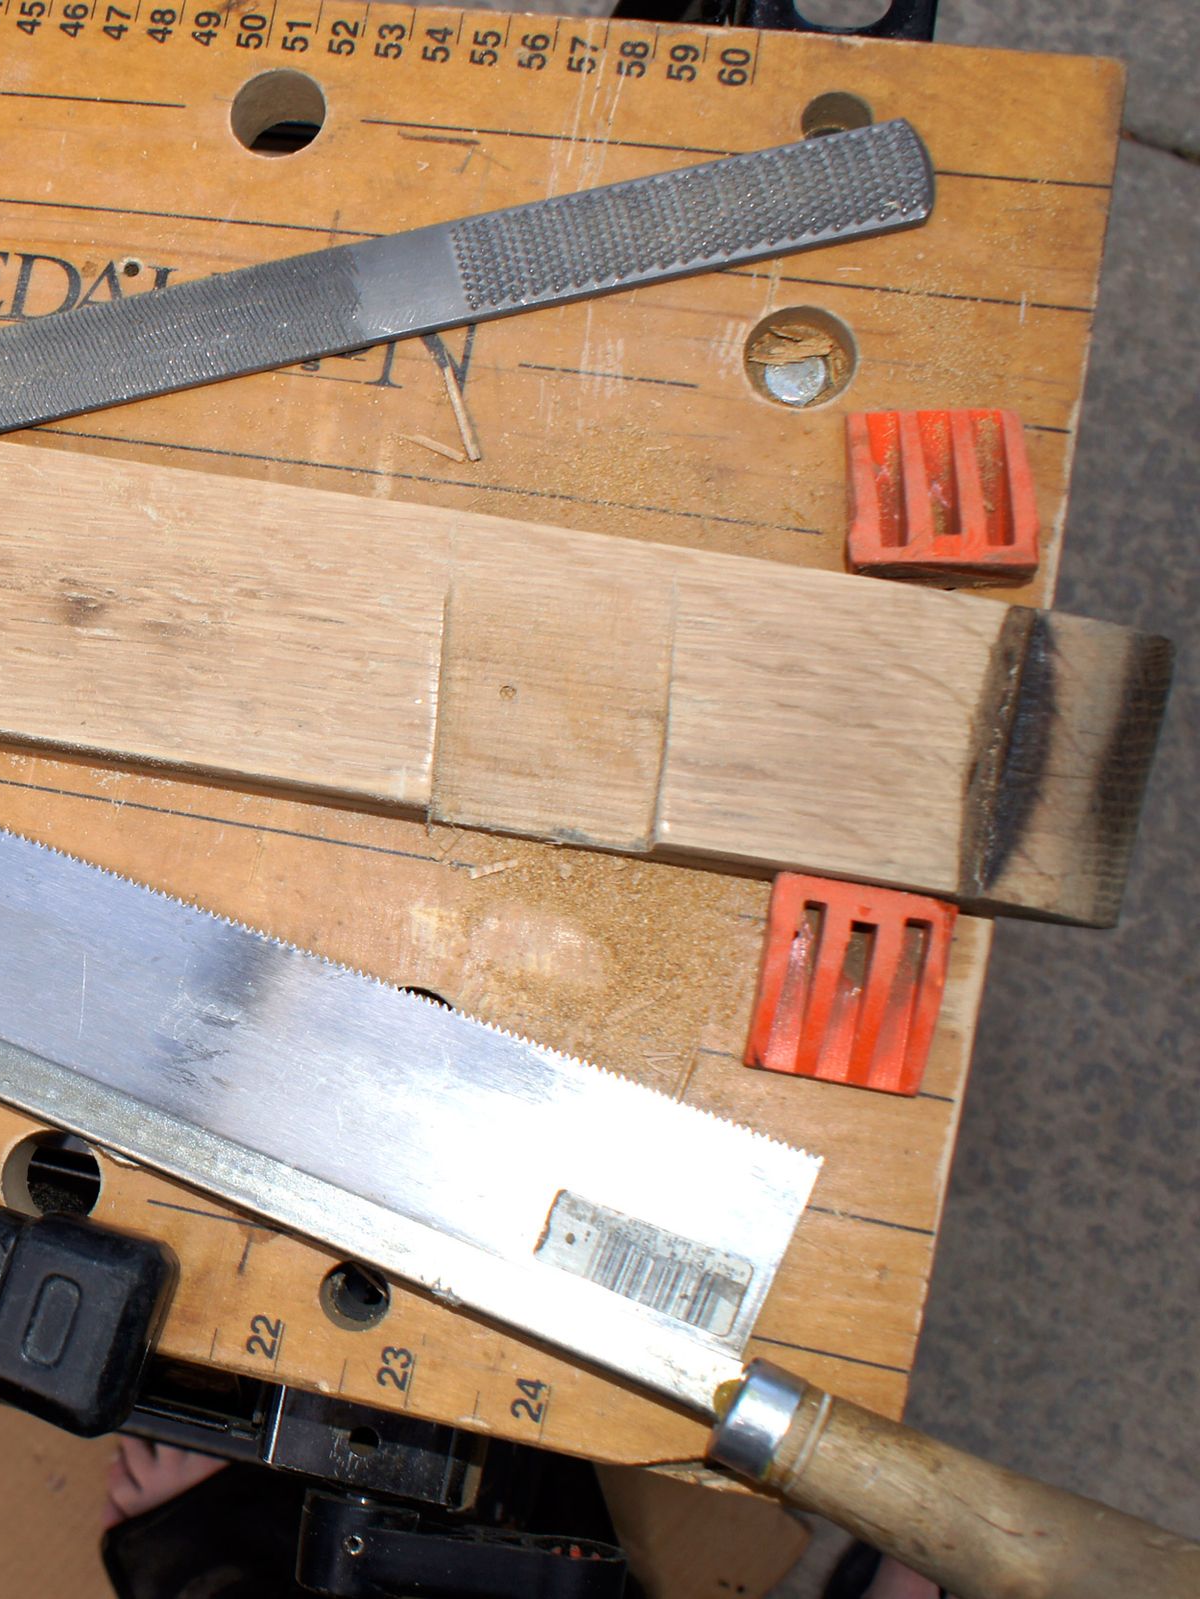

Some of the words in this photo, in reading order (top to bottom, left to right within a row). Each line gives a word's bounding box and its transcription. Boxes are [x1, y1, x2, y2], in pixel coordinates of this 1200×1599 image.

[16, 1, 46, 36] 45
[59, 3, 89, 38] 46
[102, 5, 132, 41] 47
[147, 8, 177, 44] 48
[191, 11, 222, 47] 49
[236, 14, 267, 50] 50
[281, 20, 312, 53] 51
[327, 20, 360, 57] 52
[373, 23, 407, 60] 53
[421, 26, 454, 64] 54
[469, 30, 502, 67] 55
[517, 33, 550, 71] 56
[566, 35, 599, 75] 57
[616, 40, 650, 79] 58
[666, 43, 700, 83] 59
[717, 47, 751, 87] 60
[245, 1313, 283, 1360] 22
[376, 1345, 413, 1392] 23
[510, 1376, 550, 1423] 24
